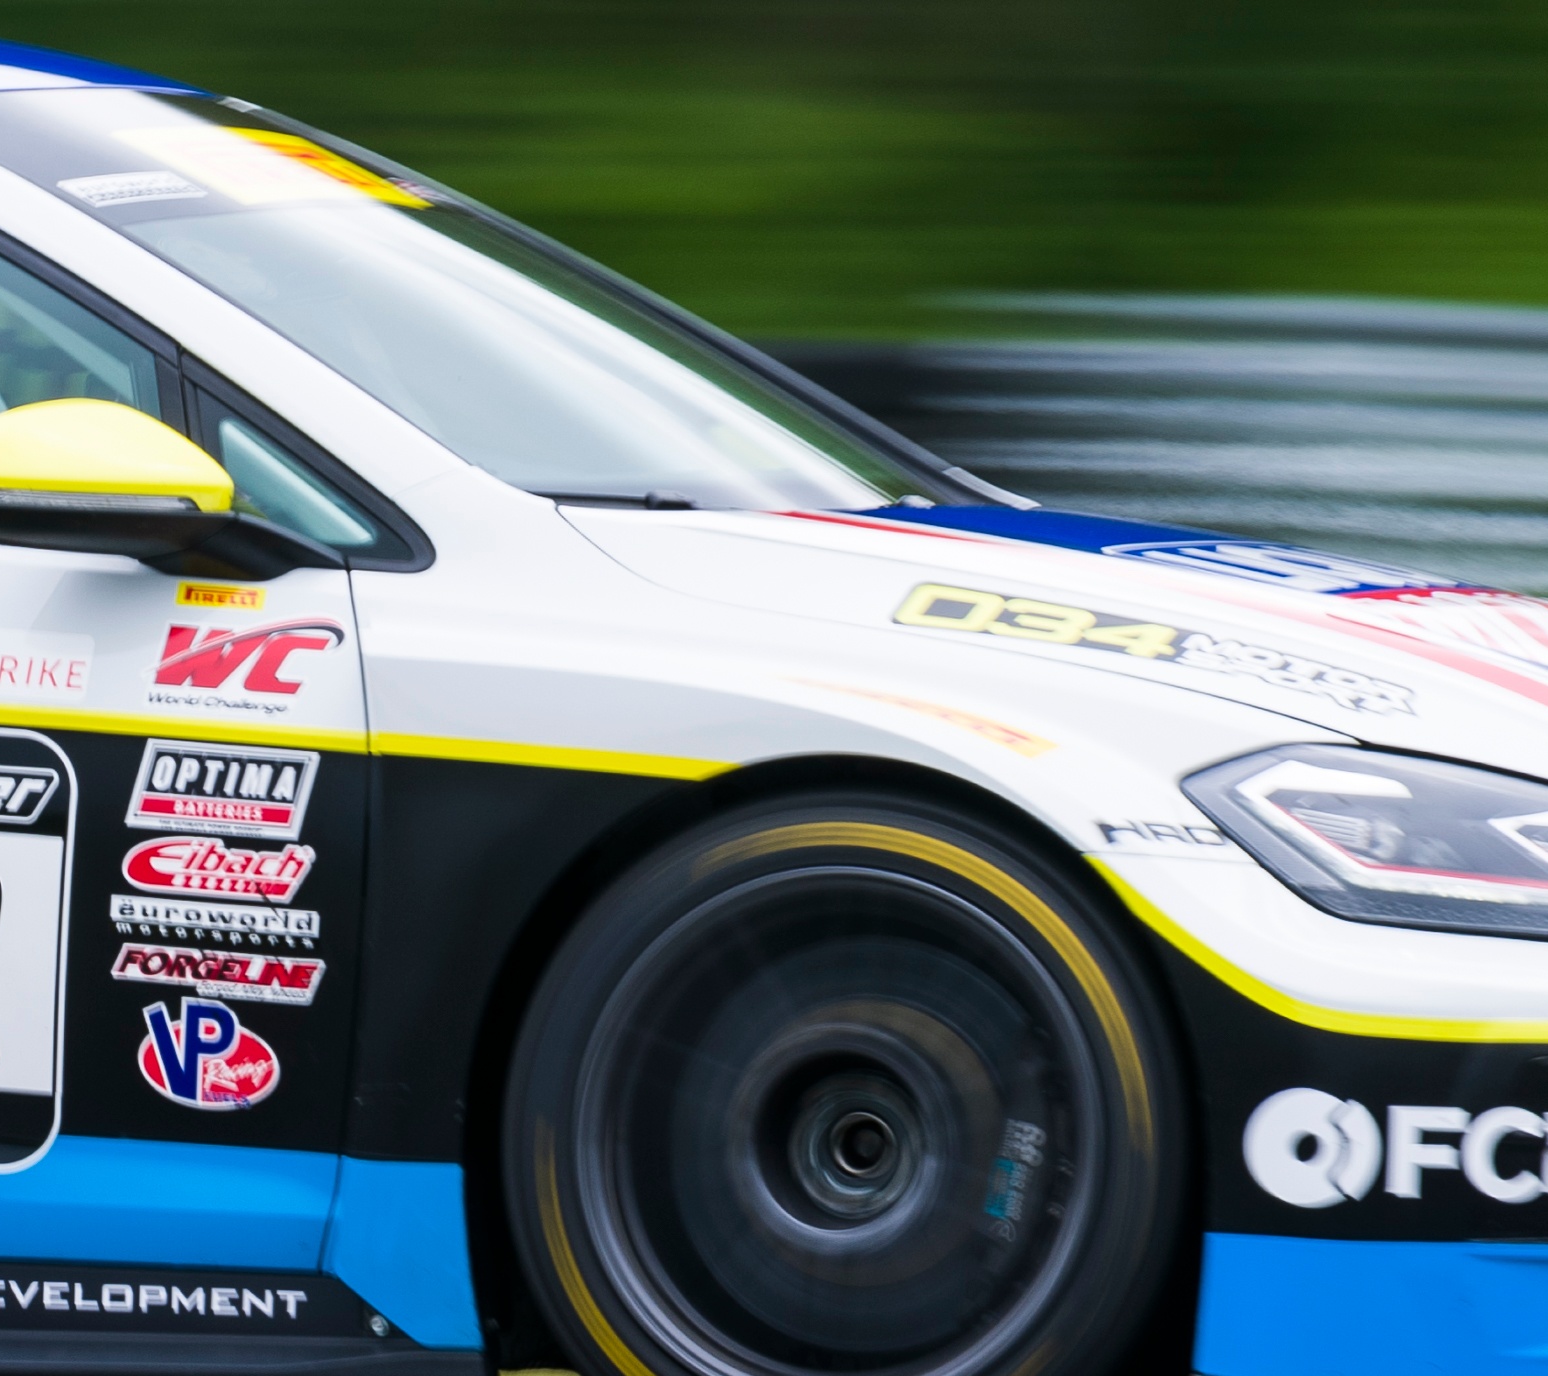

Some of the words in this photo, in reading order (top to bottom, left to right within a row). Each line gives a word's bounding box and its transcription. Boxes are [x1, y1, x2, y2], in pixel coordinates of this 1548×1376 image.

[183, 584, 259, 607] PIRELLI
[893, 584, 1180, 659] 034
[154, 624, 332, 695] WC
[151, 755, 297, 801] OPTIMA
[173, 800, 263, 821] BATTERIES
[149, 839, 307, 882] Eibach
[116, 922, 315, 949] motorsports
[118, 949, 319, 989] FORGELINE
[147, 1002, 236, 1101] VP
